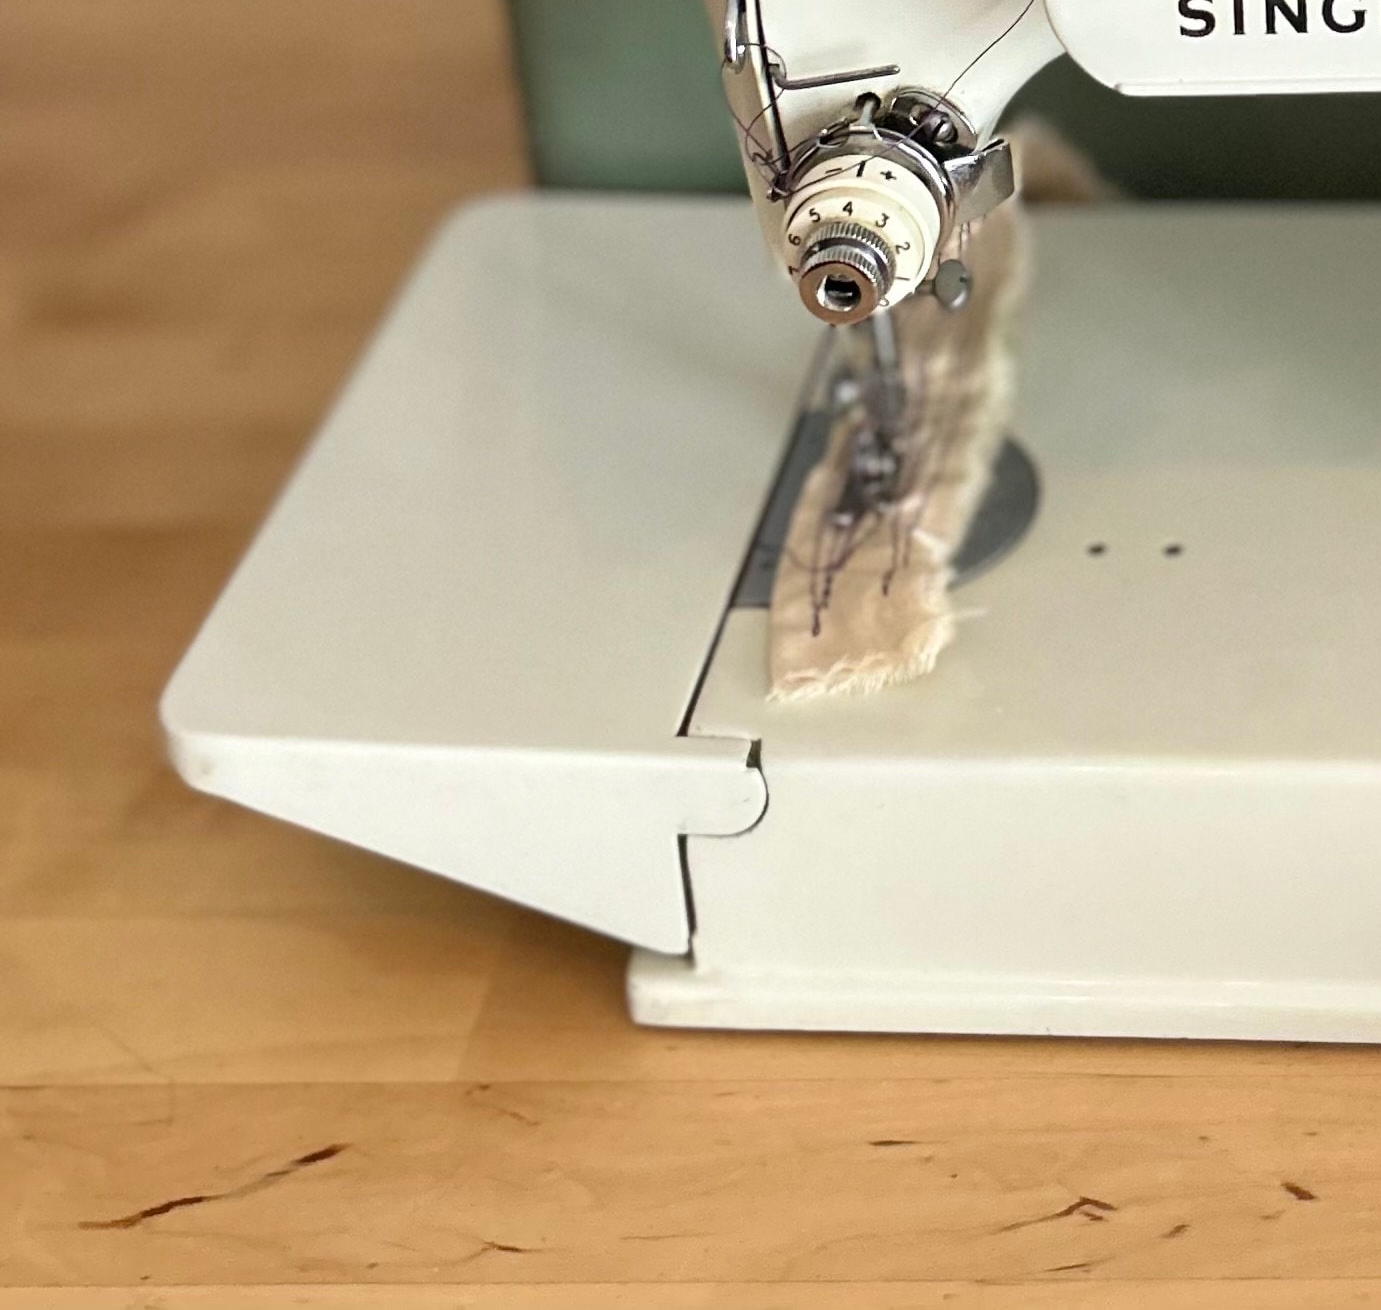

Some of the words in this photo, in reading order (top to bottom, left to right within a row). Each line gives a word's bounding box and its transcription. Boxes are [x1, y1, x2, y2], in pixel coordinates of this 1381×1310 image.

[788, 233, 801, 246] 6
[809, 208, 821, 223] 5
[842, 201, 854, 216] 4
[875, 213, 890, 228] 3
[895, 242, 911, 254] 2
